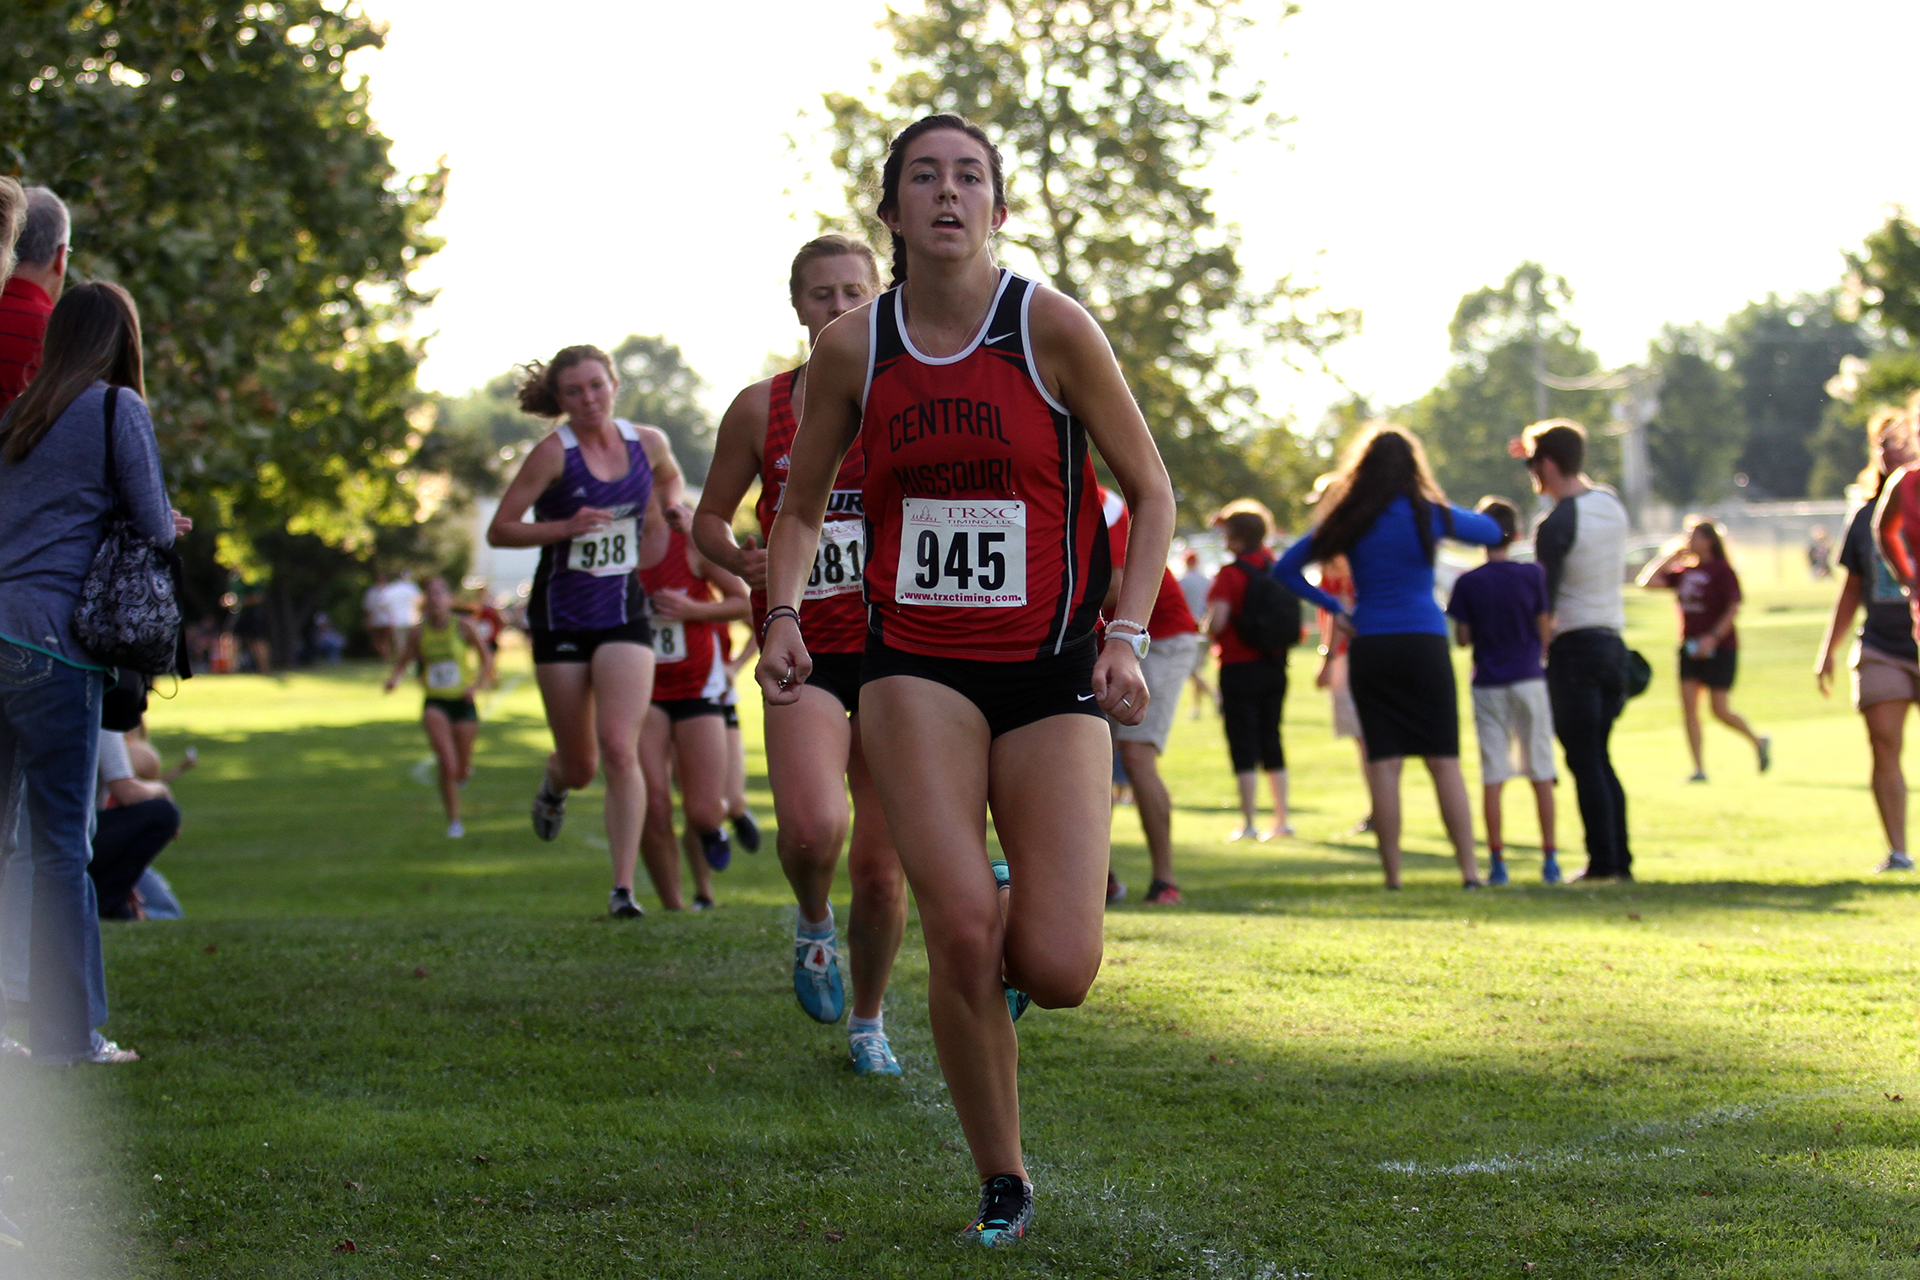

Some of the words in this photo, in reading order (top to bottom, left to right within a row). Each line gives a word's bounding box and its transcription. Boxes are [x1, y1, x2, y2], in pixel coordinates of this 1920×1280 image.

[888, 397, 1011, 453] CENTRAL
[891, 457, 1012, 496] MISSOURI
[942, 506, 1018, 519] TRXC
[581, 534, 627, 569] 938
[915, 529, 1006, 590] 945
[904, 591, 1018, 604] www.trxctiming.com
